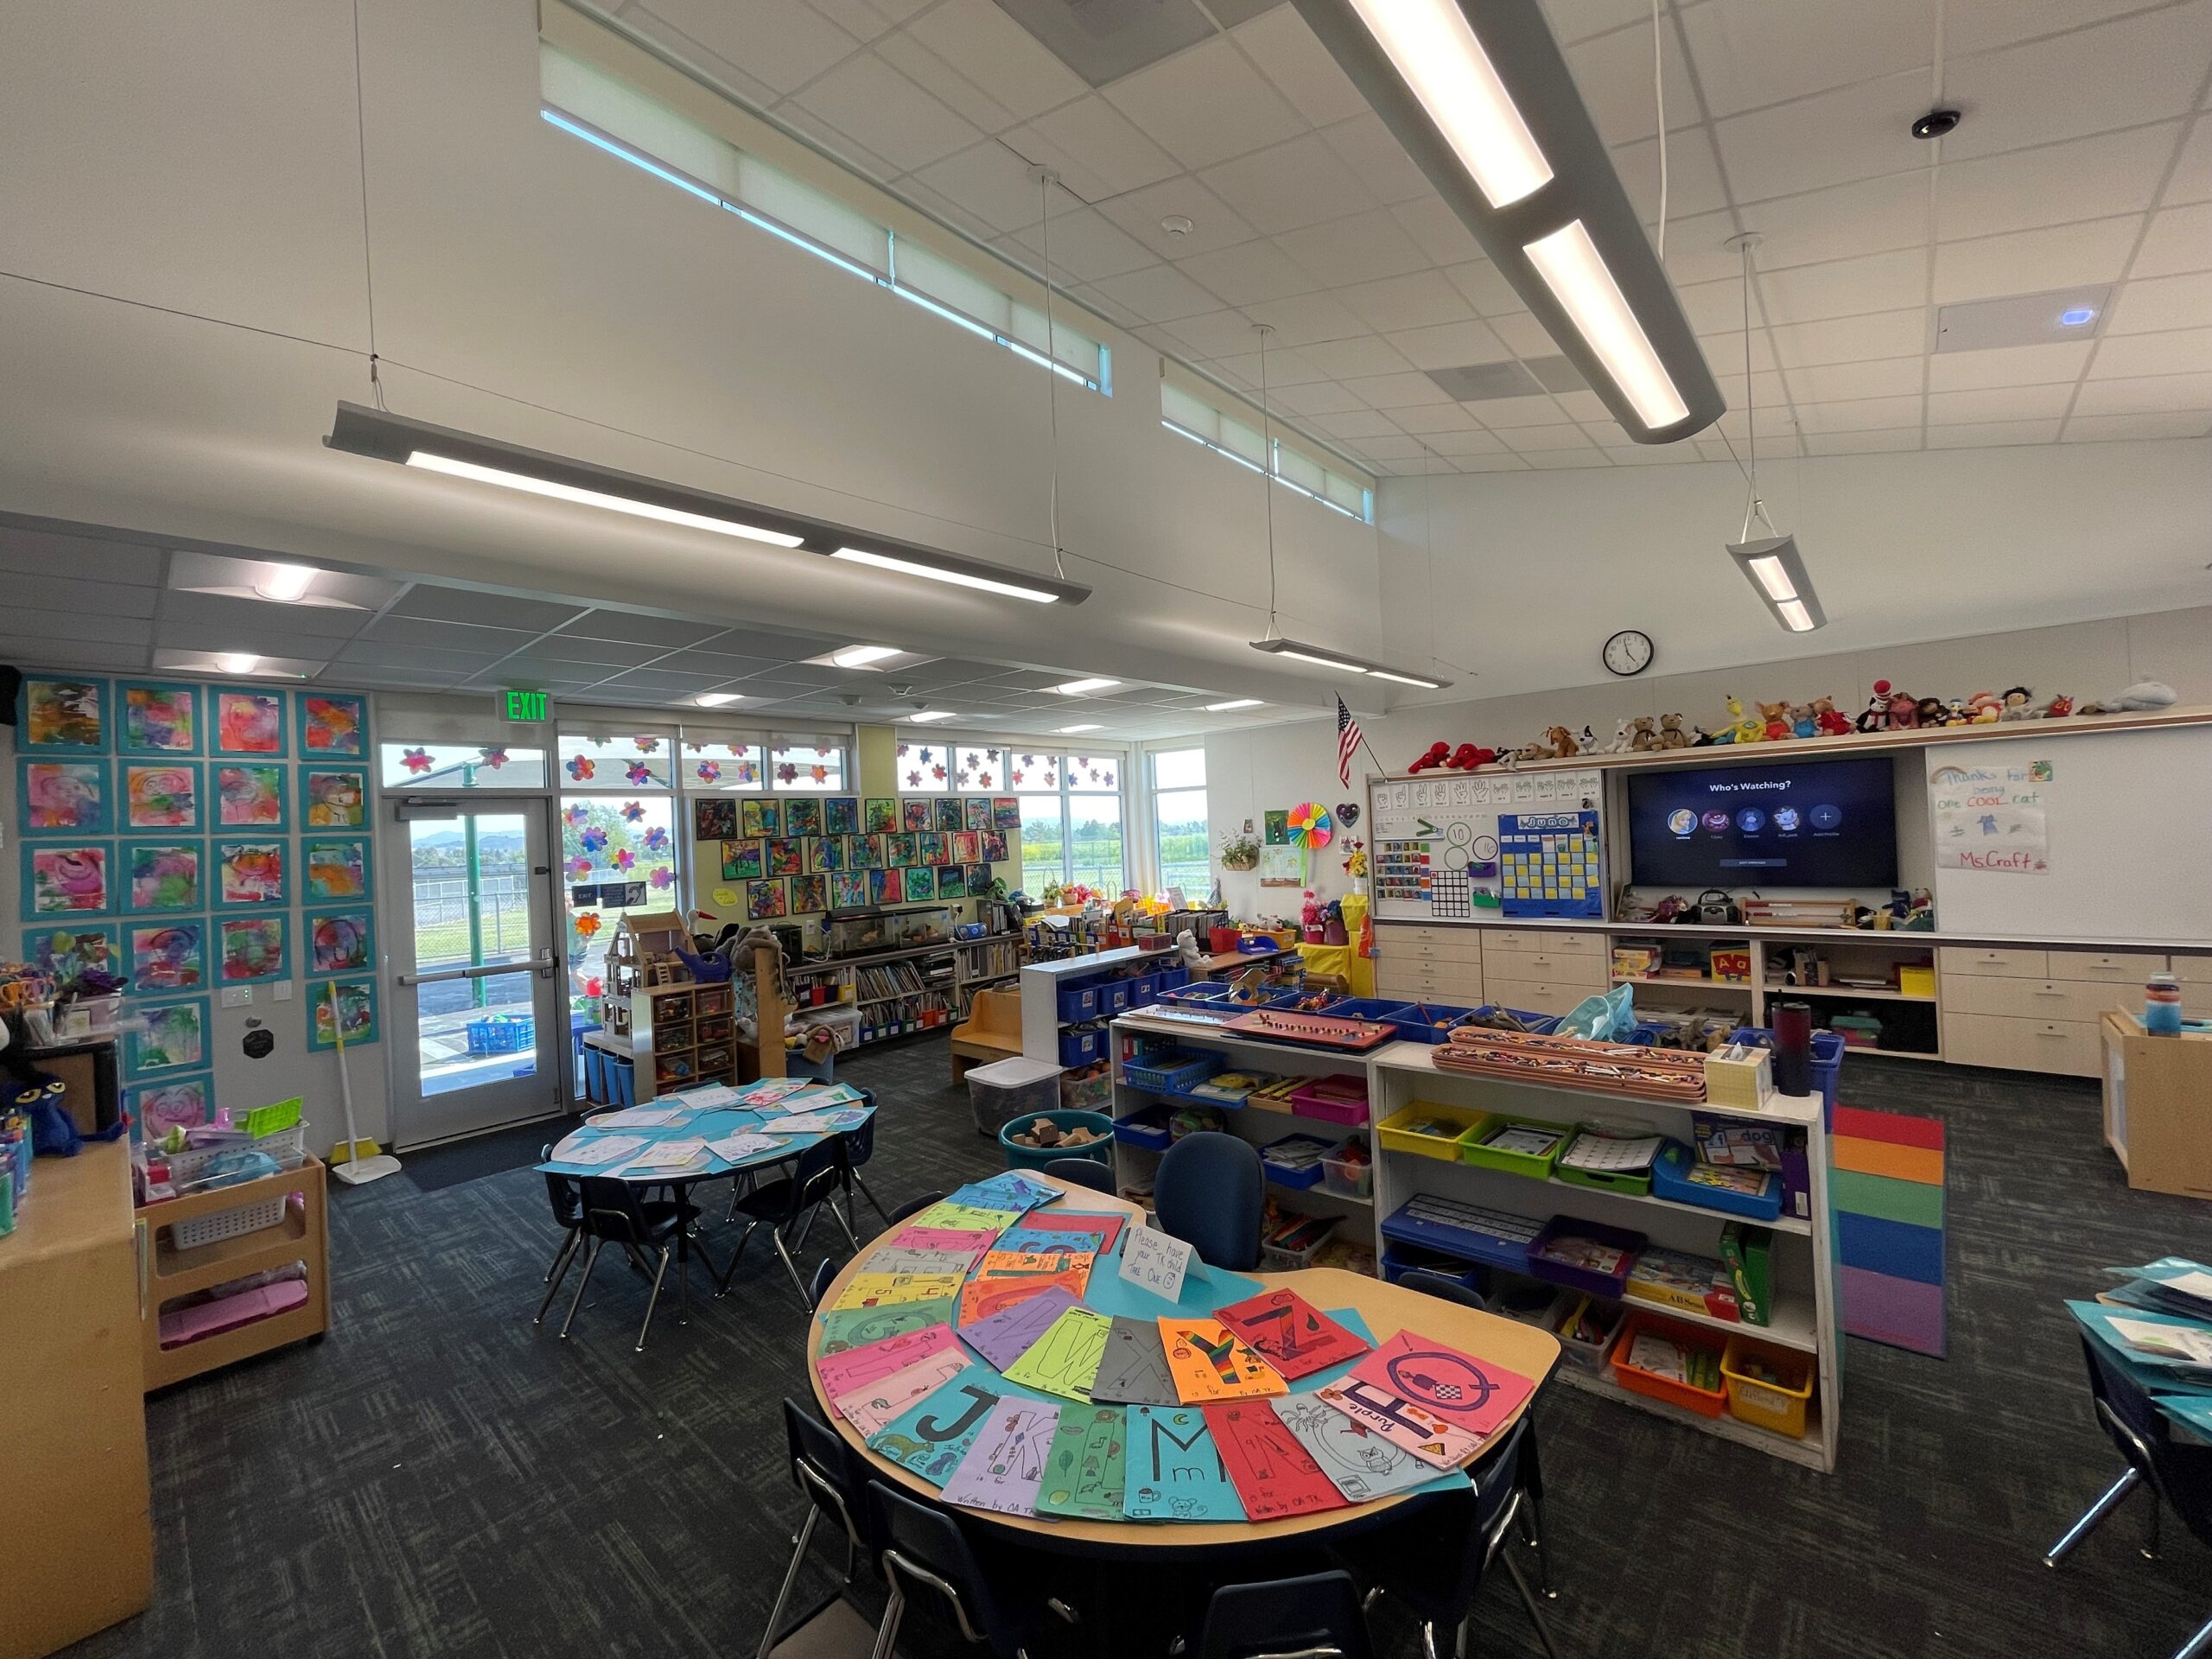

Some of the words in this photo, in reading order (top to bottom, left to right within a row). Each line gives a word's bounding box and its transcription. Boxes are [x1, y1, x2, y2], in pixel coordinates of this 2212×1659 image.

[507, 691, 547, 721] EXIT
[1709, 783, 1738, 792] Who's
[1739, 780, 1792, 791] Watching?
[1947, 768, 1998, 785] Thanks
[1967, 796, 2008, 807] COOL
[1453, 828, 1465, 840] 10
[1135, 1228, 1158, 1251] Please
[1166, 1242, 1184, 1260] have
[1135, 1250, 1150, 1264] your
[1157, 1253, 1165, 1267] TK
[1167, 1261, 1182, 1274] child
[1243, 1305, 1339, 1361] Z
[1176, 1329, 1241, 1383] Y
[1387, 1351, 1500, 1411] Q
[916, 1385, 1001, 1442] J
[1349, 1403, 1395, 1432] Purple
[987, 1410, 1058, 1483] K
[1152, 1418, 1227, 1483] M
[1173, 1467, 1205, 1482] m
[957, 1492, 986, 1507] Written
[992, 1499, 1002, 1510] by
